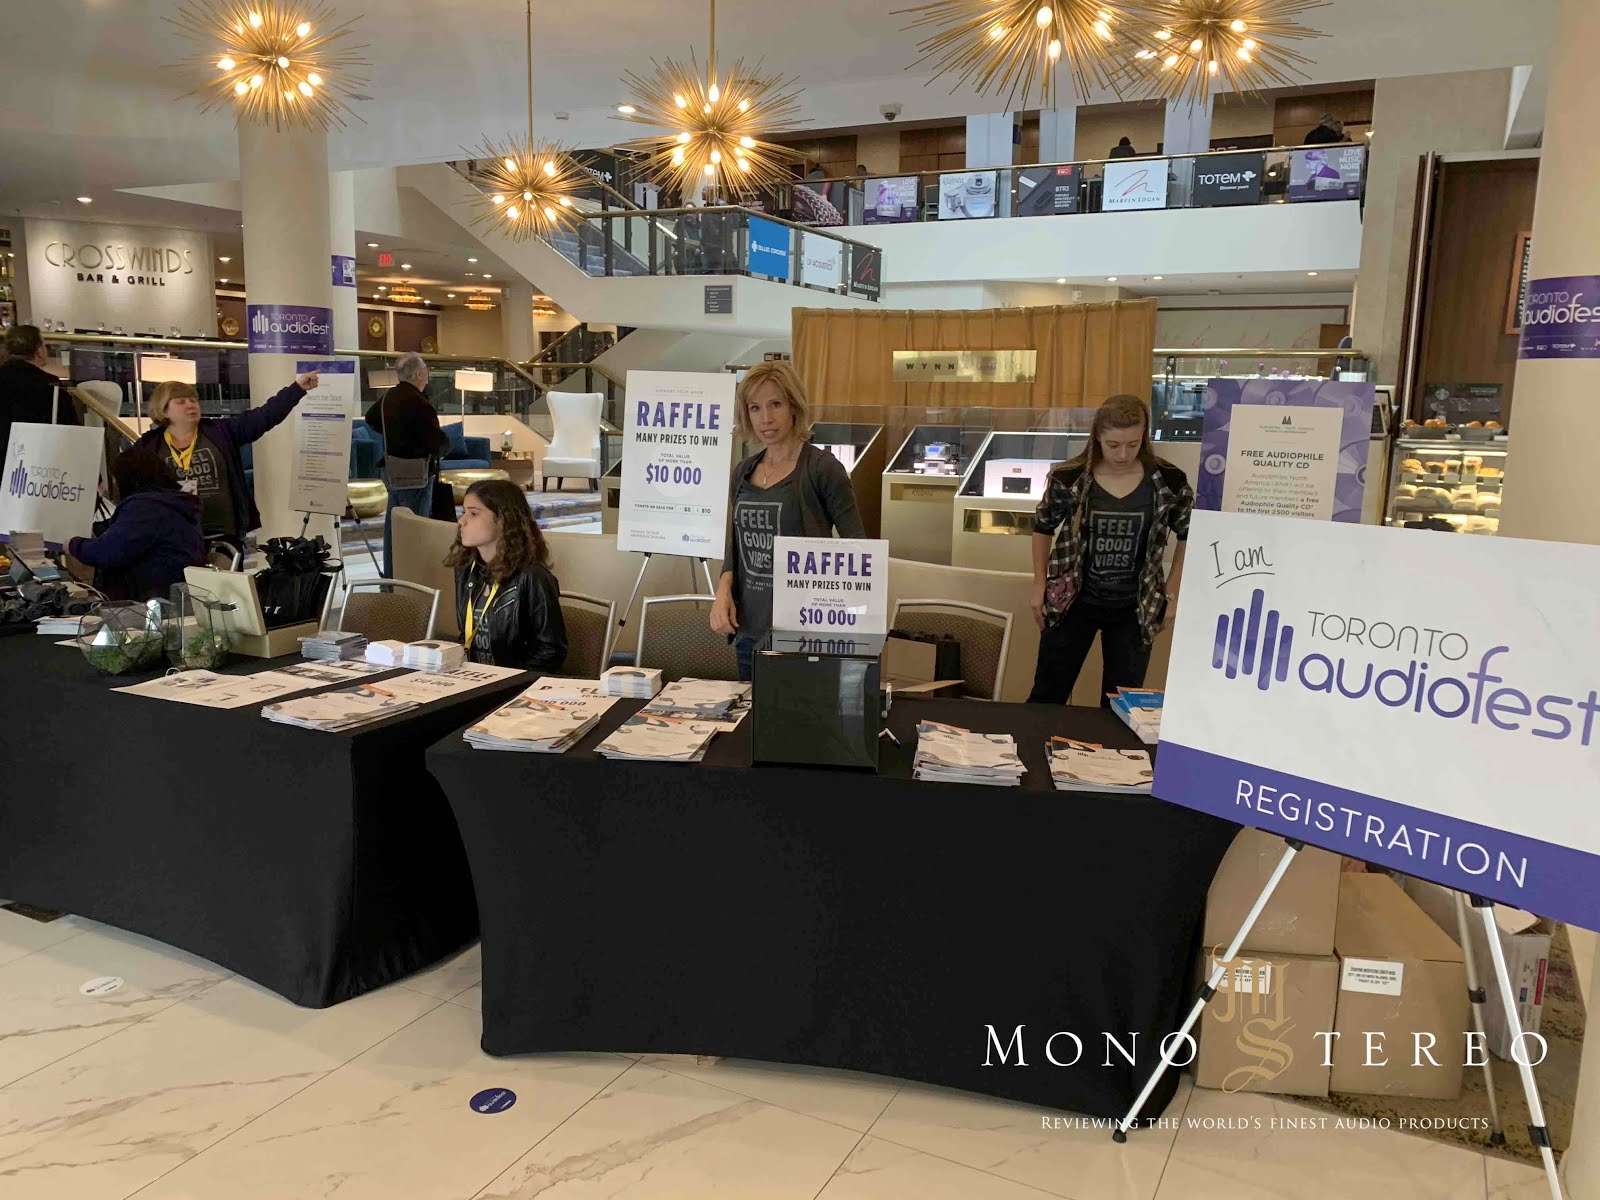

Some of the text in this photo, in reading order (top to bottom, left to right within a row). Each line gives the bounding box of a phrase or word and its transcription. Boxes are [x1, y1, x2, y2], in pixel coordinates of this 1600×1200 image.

[45, 240, 193, 274] CROSSWINDS
[77, 273, 165, 287] BAR & GRILL
[1526, 291, 1569, 305] ORONTO
[270, 316, 330, 336] audiofest
[637, 401, 720, 430] RAFFLE
[635, 432, 719, 446] MANY PRIZES TO WIN
[1240, 450, 1325, 461] FREE AUDIOPHILE
[1253, 459, 1294, 469] QUALITY
[646, 463, 702, 485] $10 000
[26, 472, 85, 502] audiofest
[740, 508, 774, 529] FEEL
[1097, 518, 1135, 536] FEEL
[743, 531, 774, 550] GOOD
[1096, 537, 1132, 552] GOOD
[747, 550, 772, 569] VIBES
[787, 551, 872, 576] RAFFLE
[1094, 554, 1130, 567] VIBES
[1210, 541, 1273, 578] I am
[787, 579, 871, 591] MANY PRIZES TO WIN
[799, 607, 857, 626] $10 000
[1308, 611, 1469, 661] TORONTO
[1298, 645, 1600, 746] audiofest
[1235, 779, 1528, 888] REGISTRATION
